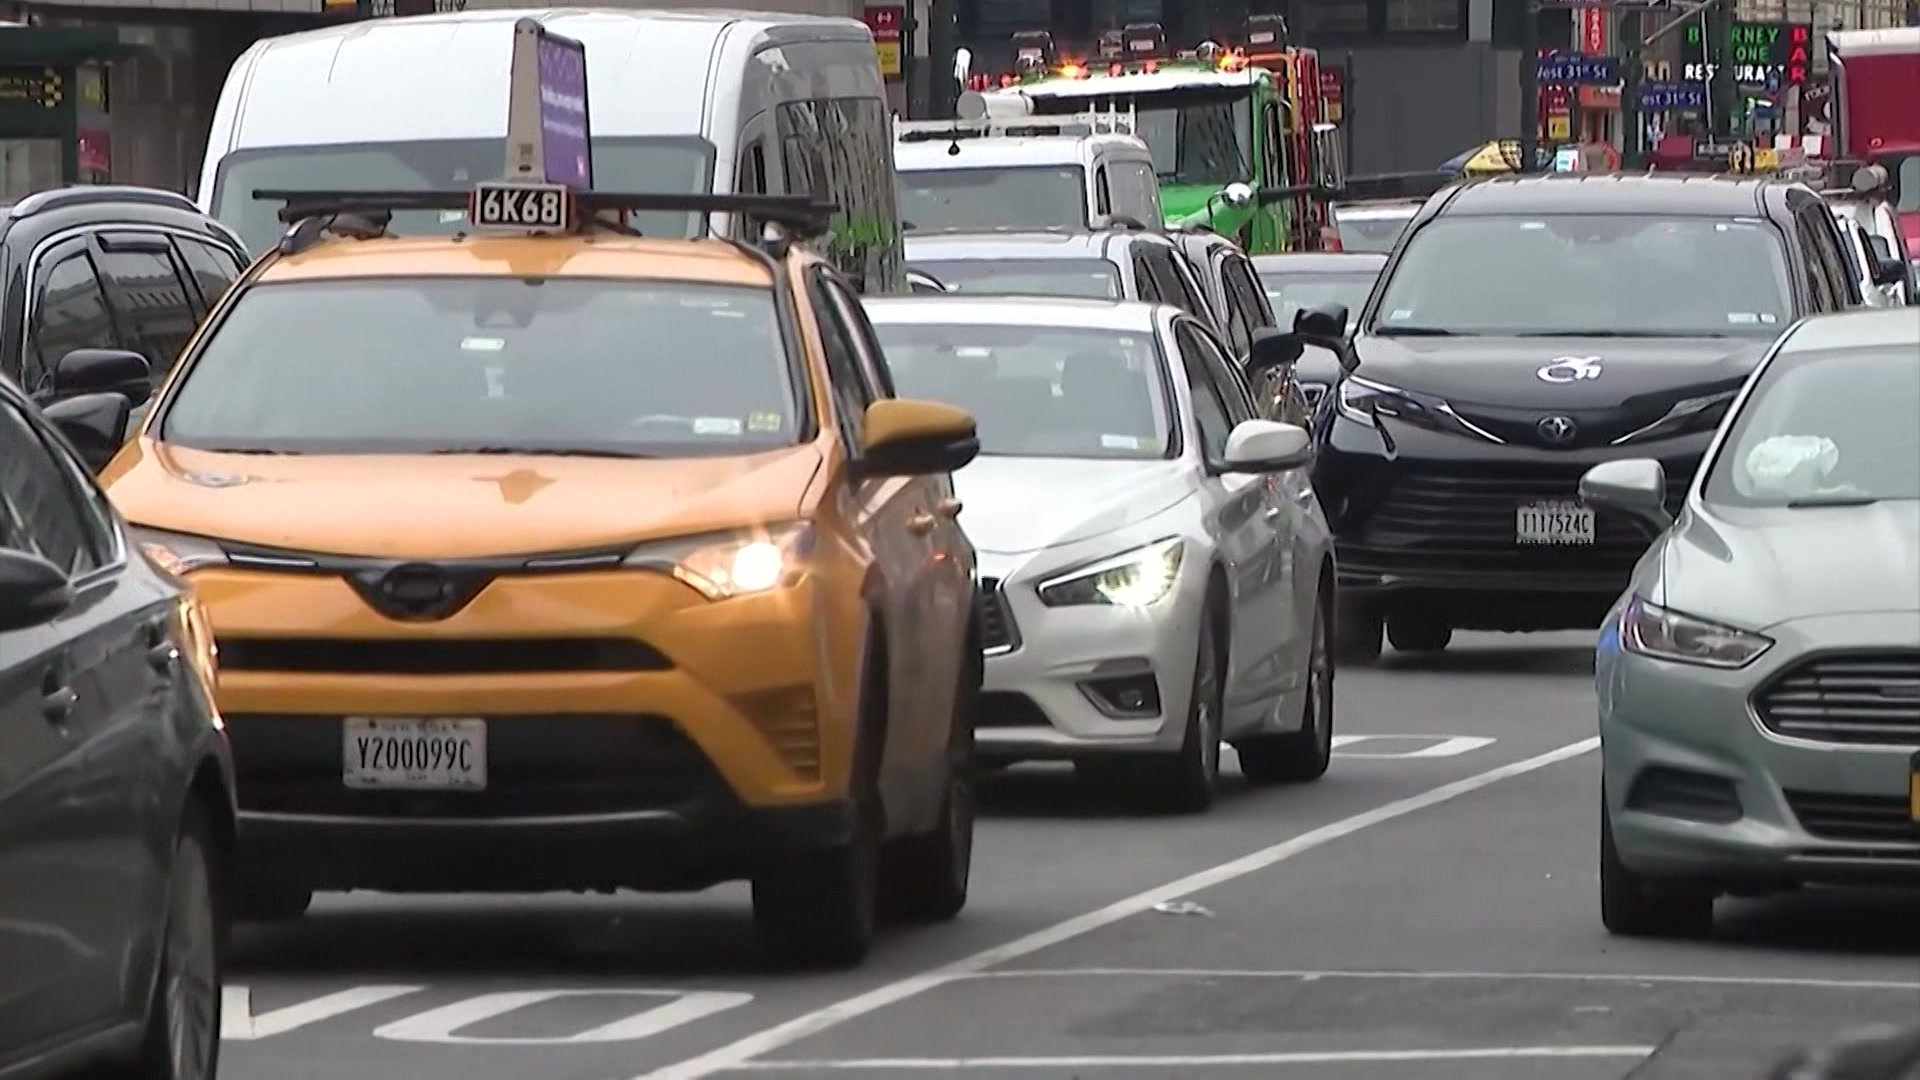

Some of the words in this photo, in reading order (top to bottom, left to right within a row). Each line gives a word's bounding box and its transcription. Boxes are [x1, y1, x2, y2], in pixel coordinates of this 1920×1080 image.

[1687, 26, 1780, 43] BRNEY
[1790, 27, 1807, 81] BAR
[483, 190, 559, 223] 6K68
[1521, 513, 1590, 534] T117524C
